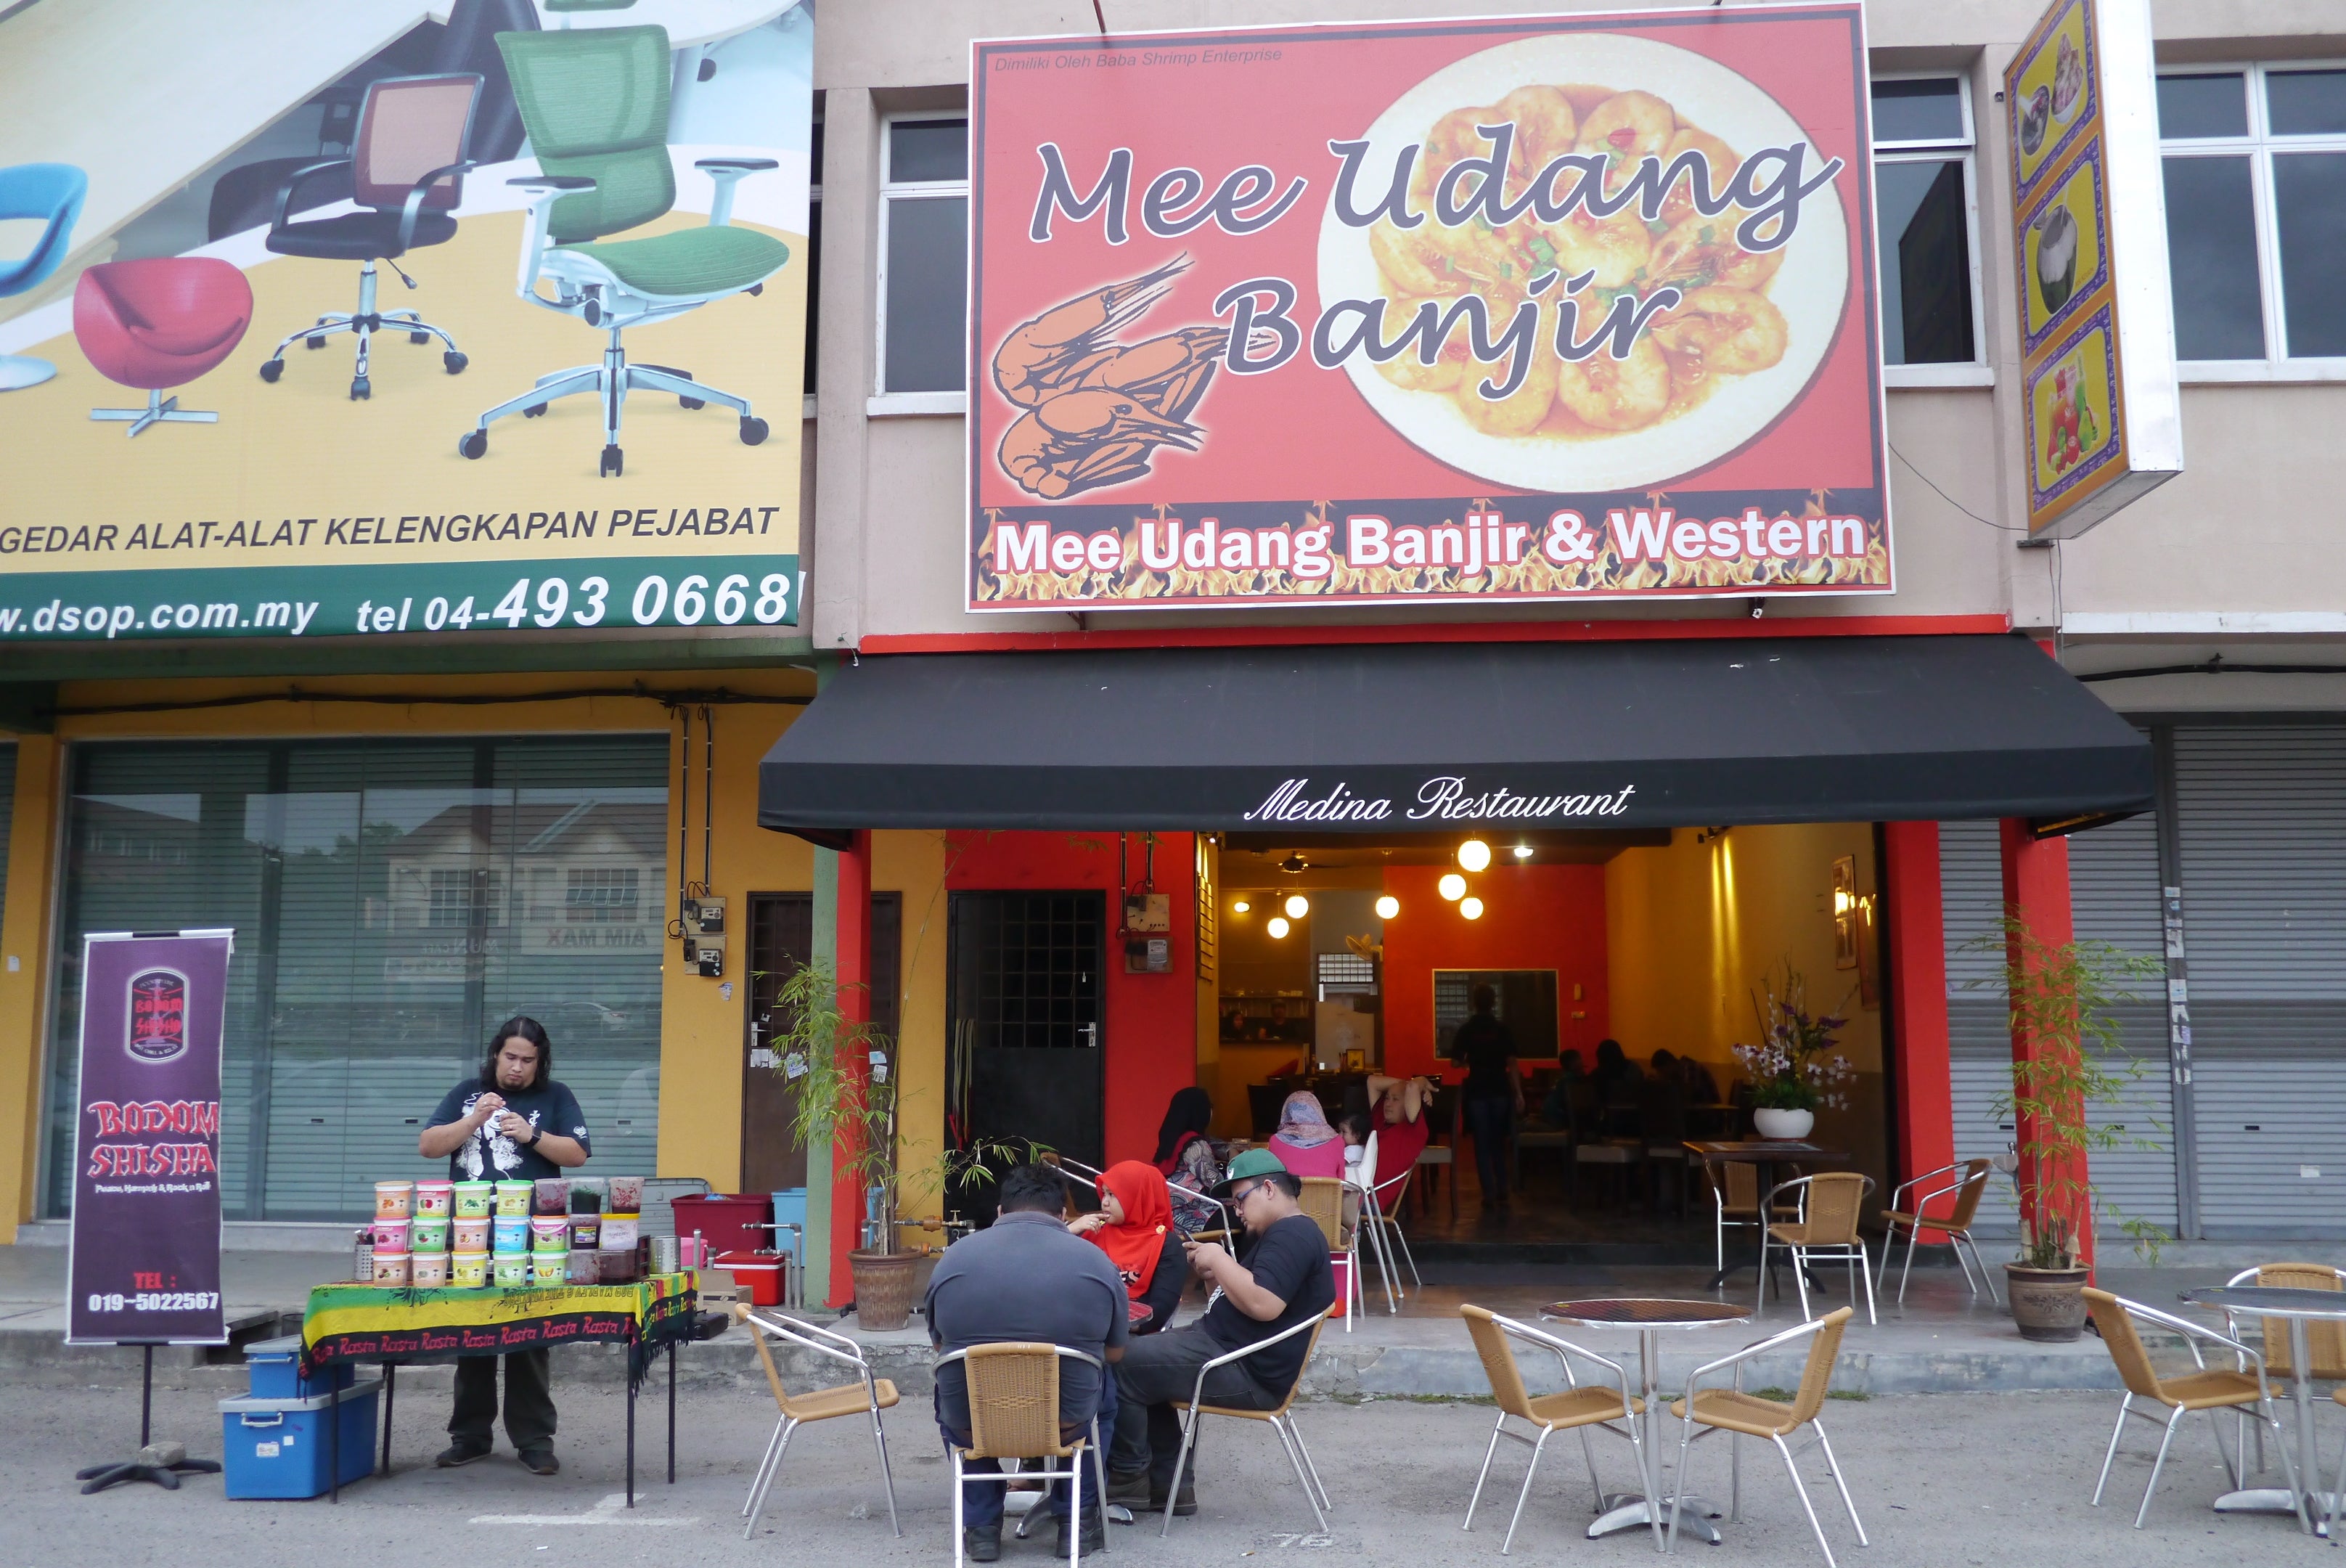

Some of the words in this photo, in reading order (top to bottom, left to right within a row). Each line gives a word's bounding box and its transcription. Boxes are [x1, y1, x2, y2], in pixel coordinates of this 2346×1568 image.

[995, 57, 1050, 71] Dimiliki
[1055, 55, 1091, 69] Oleh
[1096, 54, 1137, 68] Baba
[1142, 52, 1197, 67] Shrimp
[1202, 49, 1283, 63] Enterprise
[1029, 142, 1308, 245] Mee
[1328, 122, 1844, 254] Udang
[1213, 268, 1680, 401] Banjir
[0, 525, 118, 554] GEDAR
[126, 518, 318, 550] ALAT-ALAT
[324, 511, 598, 545] KELENGKAPAN
[608, 507, 780, 537] PEJABAT
[995, 523, 1121, 571] Mee
[1138, 518, 1333, 576] Udang
[1349, 514, 1526, 576] Banjir
[1544, 512, 1595, 562] &
[1609, 508, 1866, 560] Western
[356, 598, 412, 632] tel
[424, 578, 610, 630] 04-493
[1243, 778, 1393, 821] Medina
[1407, 776, 1635, 820] Restaurant
[87, 1100, 218, 1140] BODOM
[87, 1143, 216, 1178] SHISHA
[158, 1183, 166, 1193] &
[134, 1272, 163, 1289] TEL
[89, 1291, 219, 1312] 019-5022567
[340, 1337, 376, 1355] Rasta
[422, 1332, 458, 1351] Rasta
[500, 1326, 537, 1344] Rasta
[542, 1320, 577, 1339] Rasta
[582, 1315, 619, 1334] Rasta
